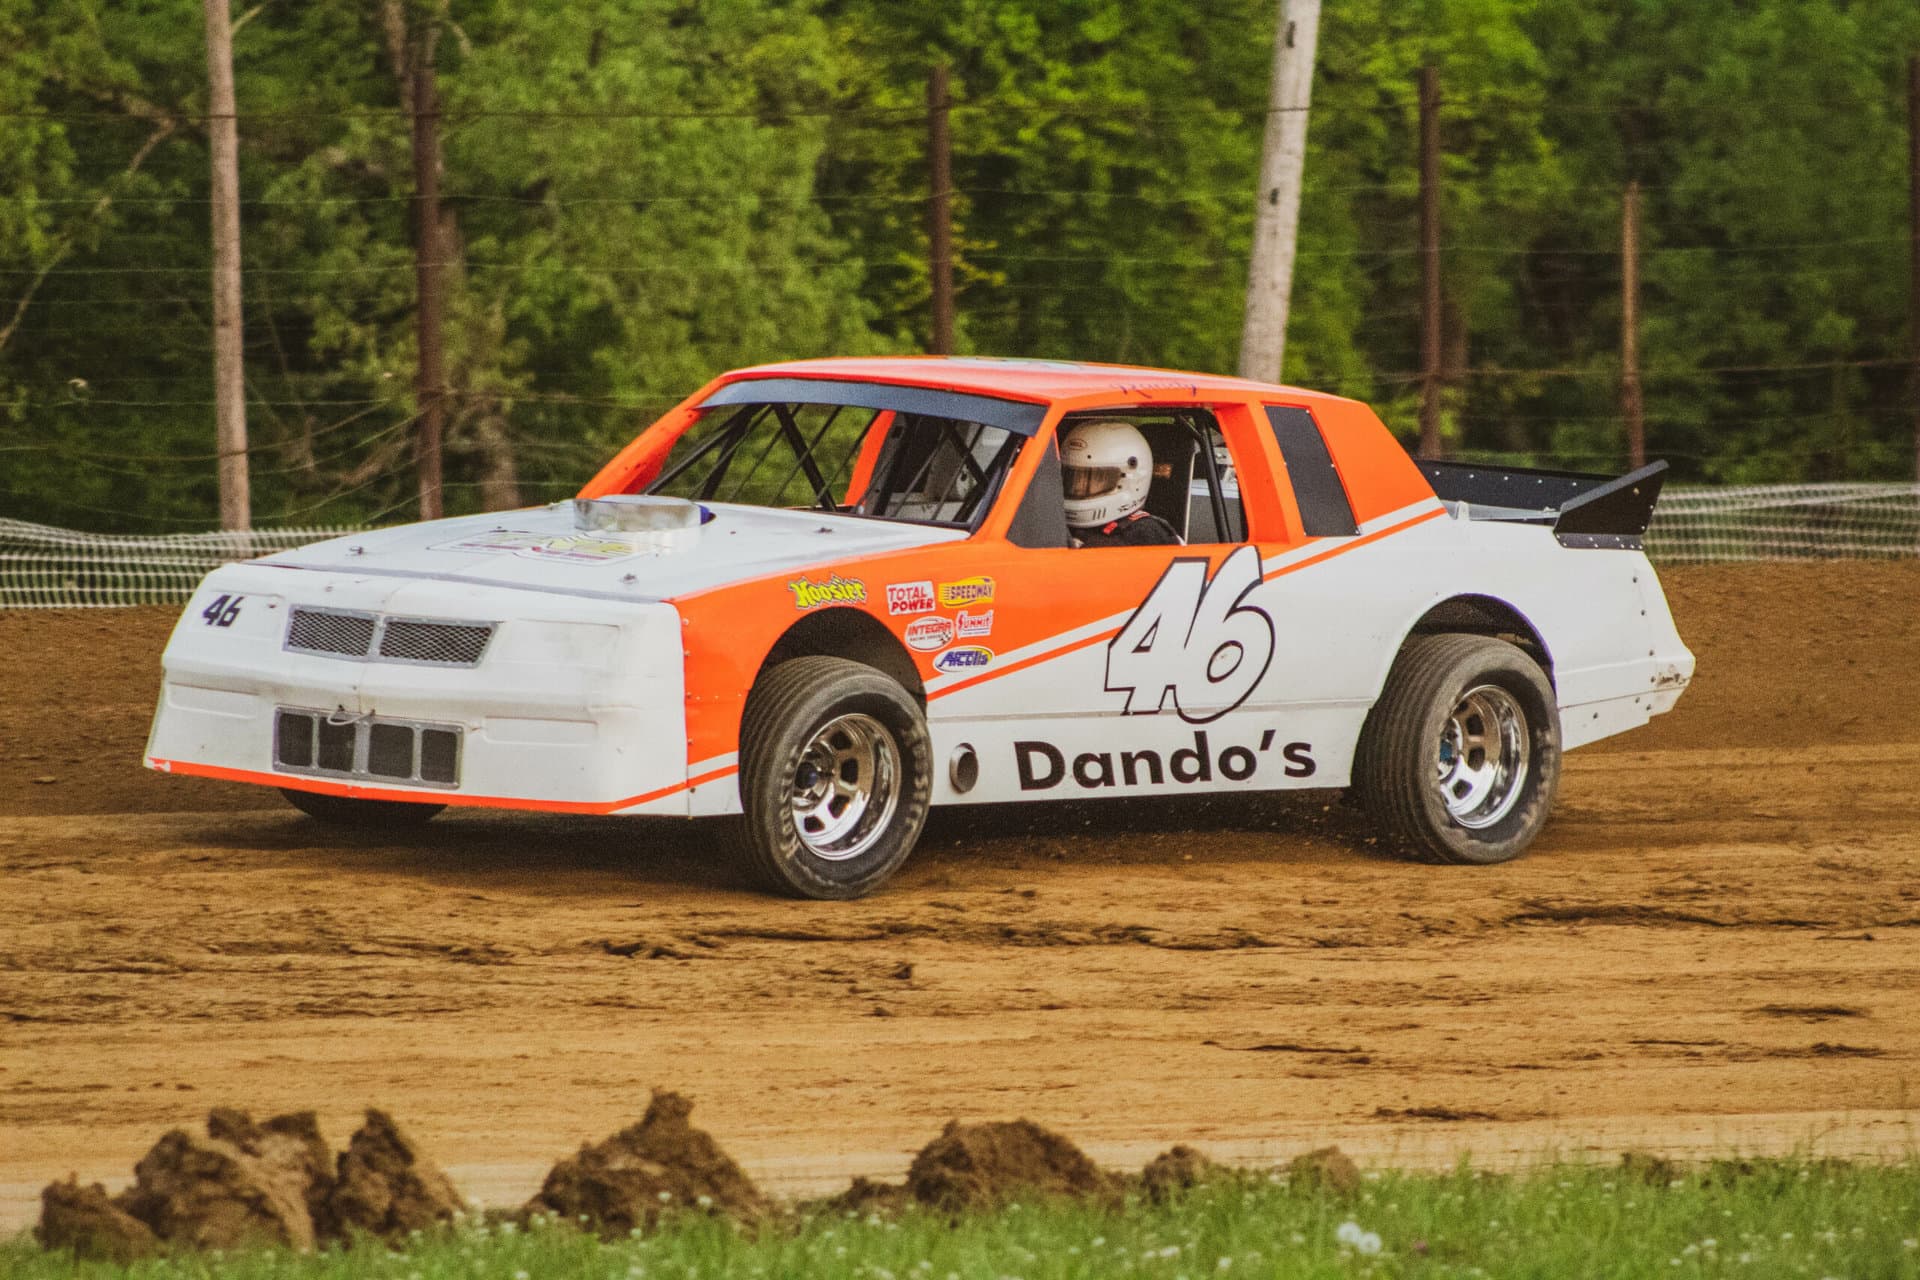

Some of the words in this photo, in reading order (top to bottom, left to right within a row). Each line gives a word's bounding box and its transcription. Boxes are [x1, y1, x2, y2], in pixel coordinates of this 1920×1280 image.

[888, 586, 927, 601] TOTAL
[950, 583, 993, 600] SPEEDWAY
[203, 594, 245, 627] 46
[891, 598, 934, 613] POWER
[1103, 544, 1275, 725] 46
[1013, 728, 1317, 791] Dando's
